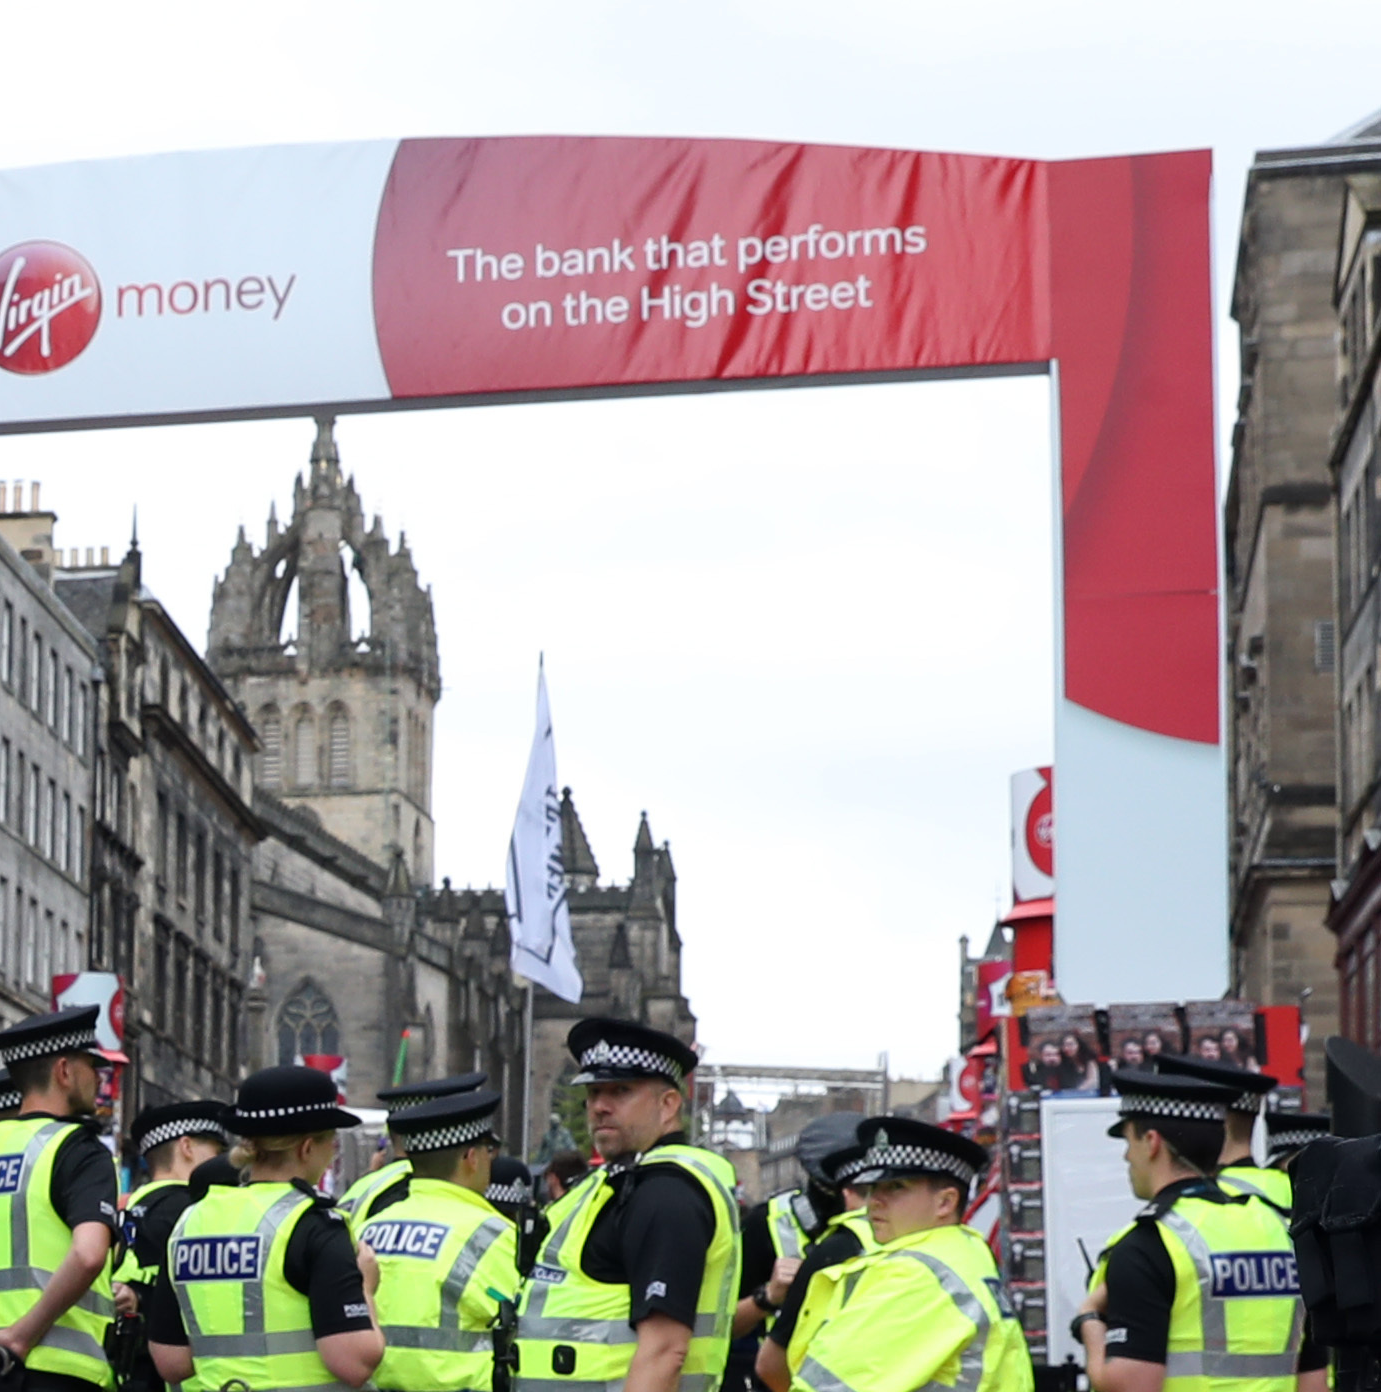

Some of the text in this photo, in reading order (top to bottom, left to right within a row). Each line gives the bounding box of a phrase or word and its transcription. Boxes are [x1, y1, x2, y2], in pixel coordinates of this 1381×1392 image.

[447, 223, 927, 283] The bank that performs
[117, 273, 297, 321] money
[501, 274, 873, 331] on the High Street
[175, 1236, 258, 1276] POLICE
[363, 1221, 446, 1256] POLICE
[1215, 1256, 1300, 1291] POLICE
